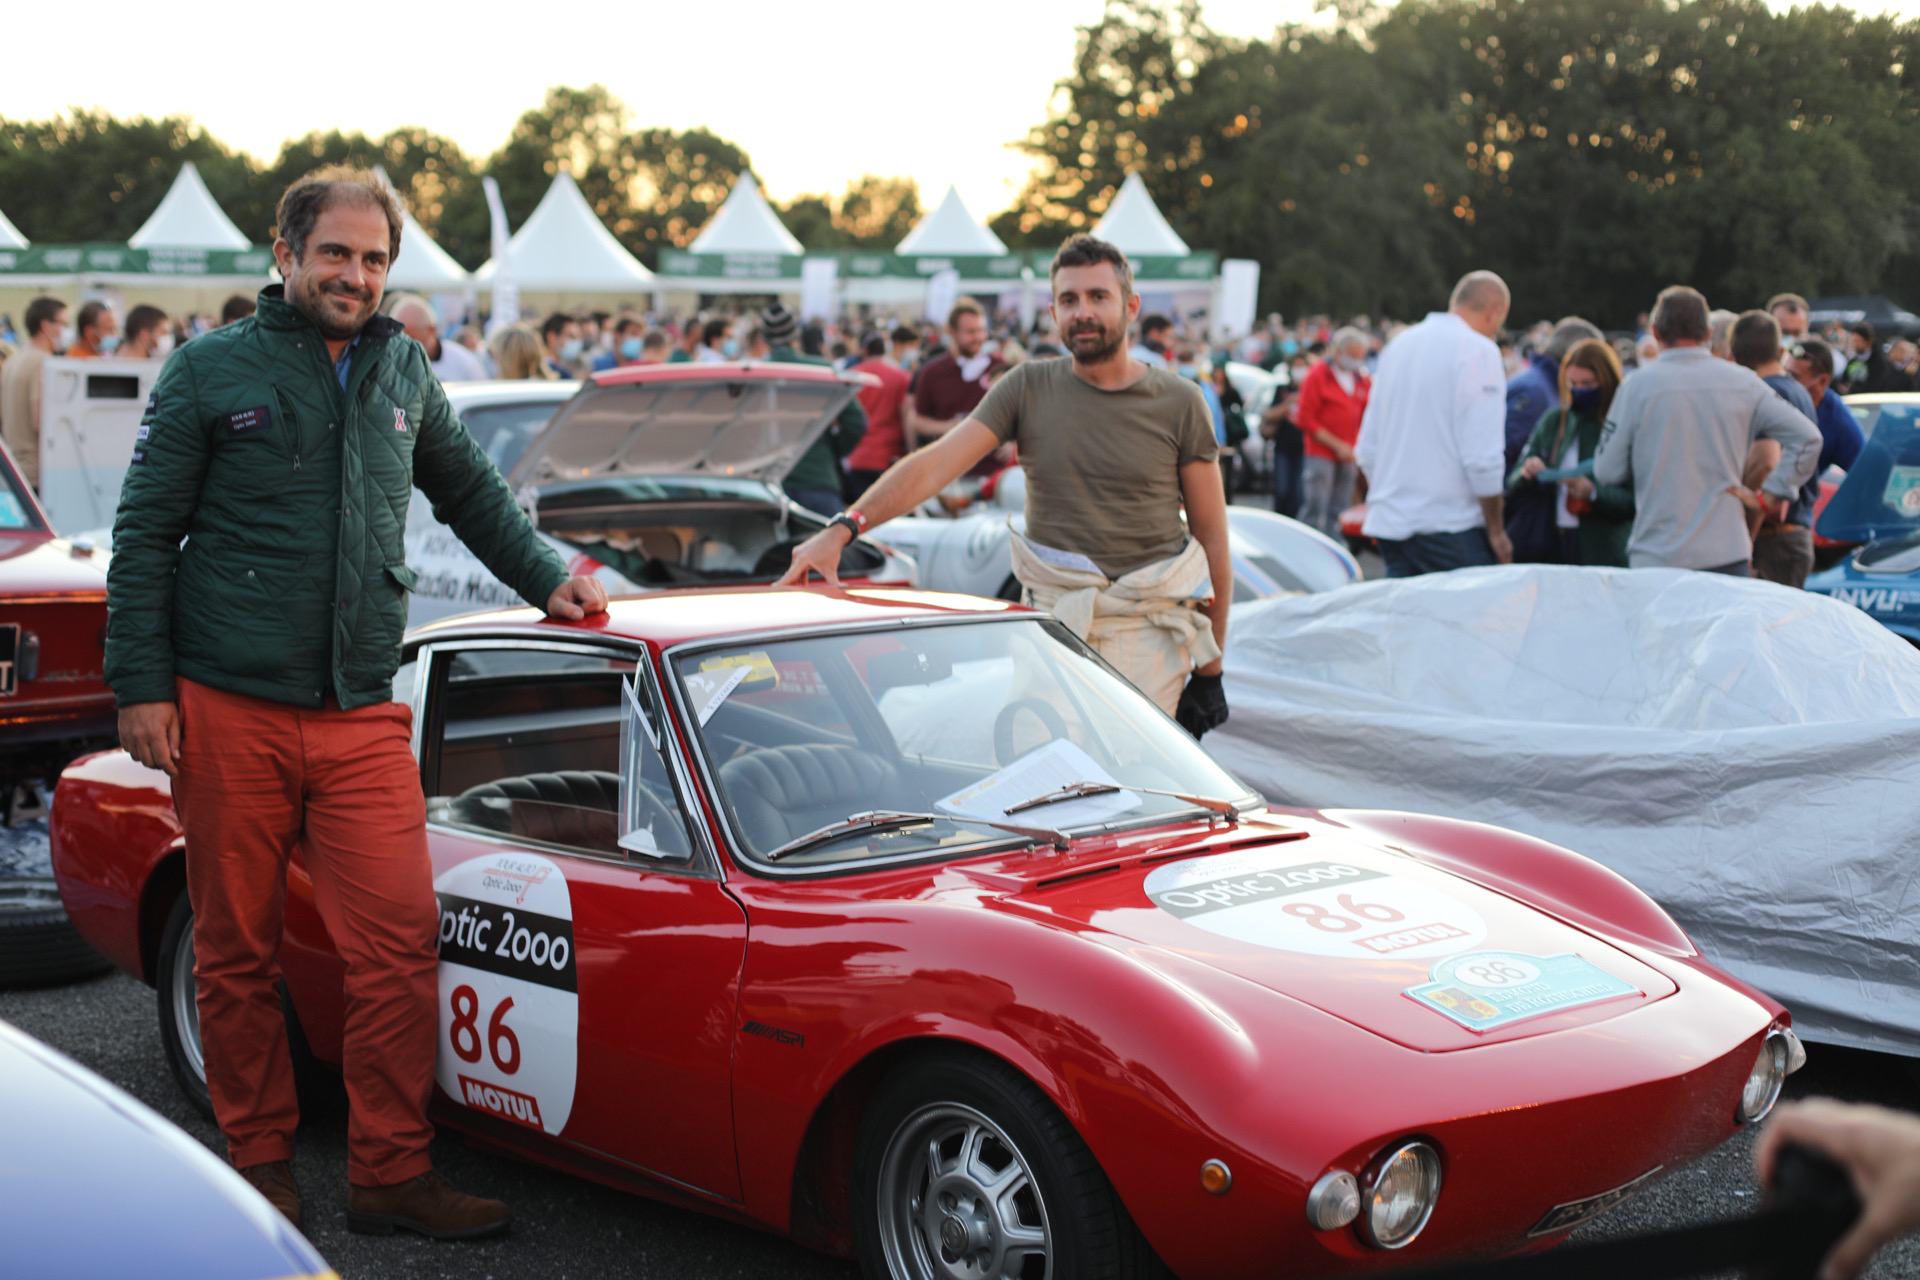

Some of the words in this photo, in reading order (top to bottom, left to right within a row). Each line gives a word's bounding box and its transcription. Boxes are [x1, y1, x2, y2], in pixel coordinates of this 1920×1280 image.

[1160, 879, 1275, 907] Optic
[1256, 864, 1361, 888] 2000
[1281, 893, 1406, 933] 86
[437, 905, 492, 954] ptic
[495, 911, 569, 971] 2000
[1363, 925, 1463, 952] MOTUL
[1468, 961, 1528, 984] 86
[450, 984, 521, 1076] 86
[466, 1082, 539, 1125] MOTUL
